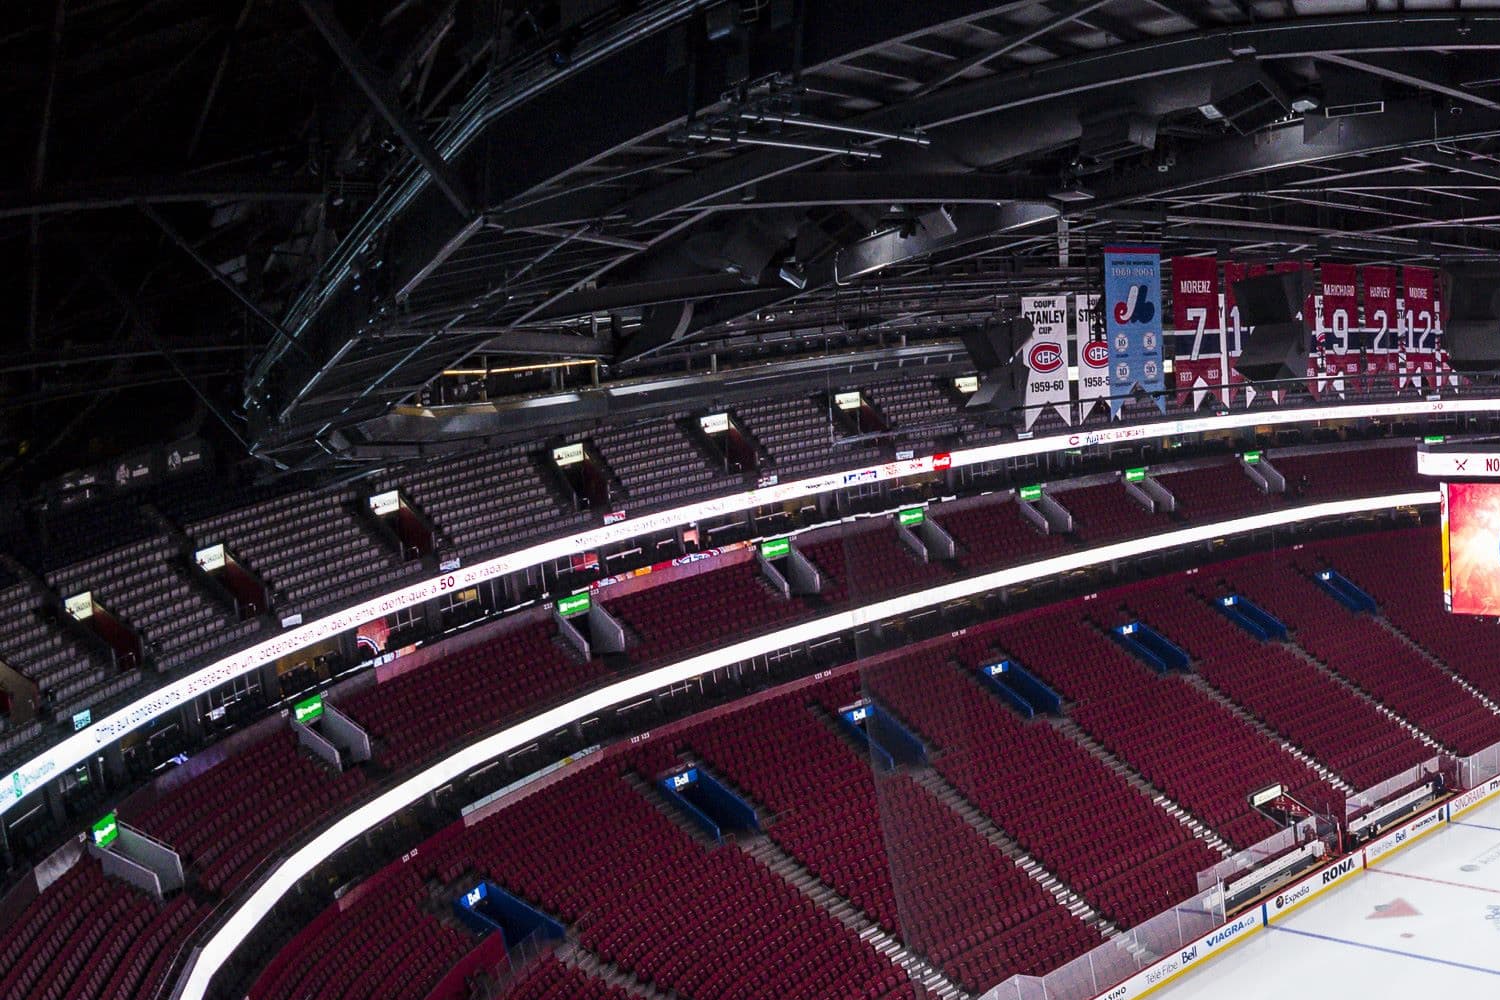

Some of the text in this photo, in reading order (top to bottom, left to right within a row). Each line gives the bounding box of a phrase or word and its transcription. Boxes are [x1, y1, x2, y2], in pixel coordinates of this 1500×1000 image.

[1180, 280, 1211, 293] MORENZ
[1370, 287, 1390, 297] HARVEY
[1409, 287, 1428, 299] MOORE
[1033, 300, 1056, 308] COUPE
[1024, 310, 1065, 325] STANLEY
[1038, 327, 1052, 335] CUP
[1186, 308, 1207, 361] 7
[1333, 309, 1349, 355] 9
[1373, 310, 1387, 354] 2
[1406, 310, 1431, 354] 12
[1030, 382, 1064, 393] 1959-60
[1084, 377, 1110, 388] 1958-5
[440, 576, 455, 590] 50
[1322, 858, 1356, 885] RONA
[1284, 885, 1310, 906] Expedia
[1182, 946, 1198, 964] Bell
